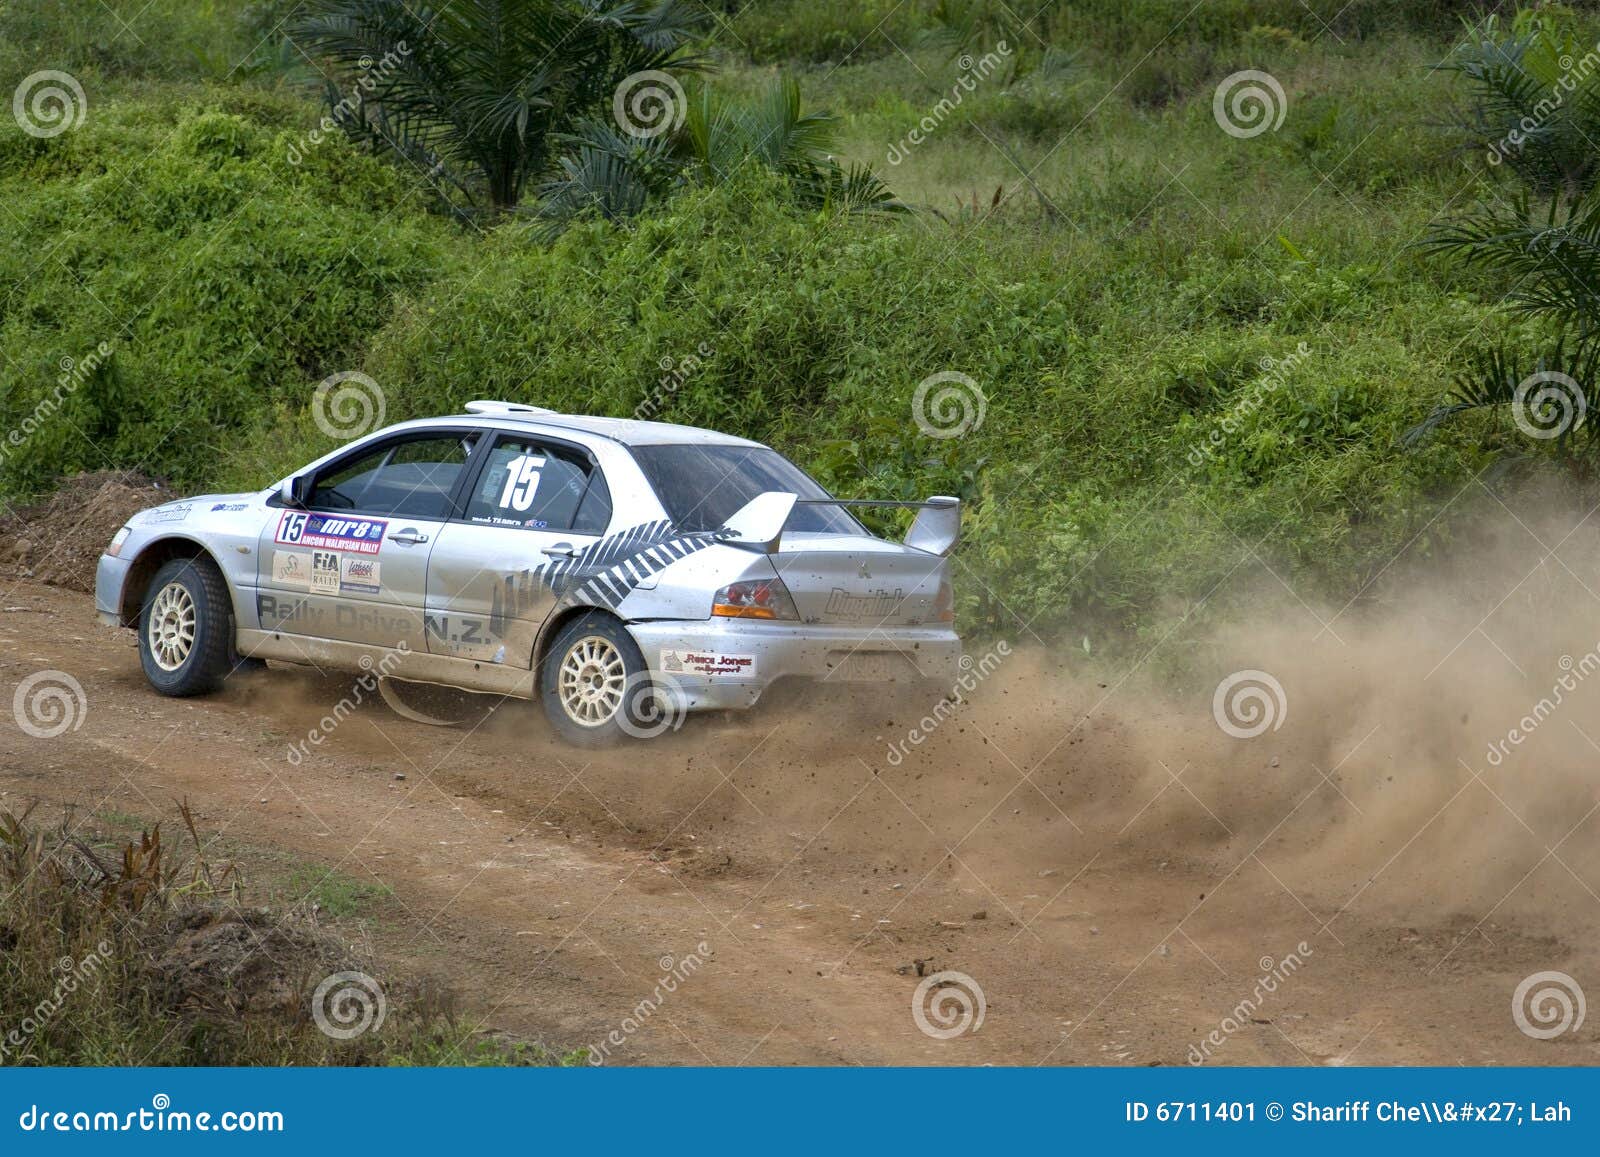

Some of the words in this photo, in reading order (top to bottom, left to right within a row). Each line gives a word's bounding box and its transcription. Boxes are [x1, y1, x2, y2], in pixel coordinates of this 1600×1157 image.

[499, 455, 547, 512] 15
[281, 513, 307, 542] 15
[320, 519, 371, 538] mr8
[360, 542, 379, 553] RALLY
[312, 575, 337, 586] RALLY
[258, 594, 324, 623] Rally
[336, 603, 412, 633] Drive
[718, 656, 752, 666] Jones
